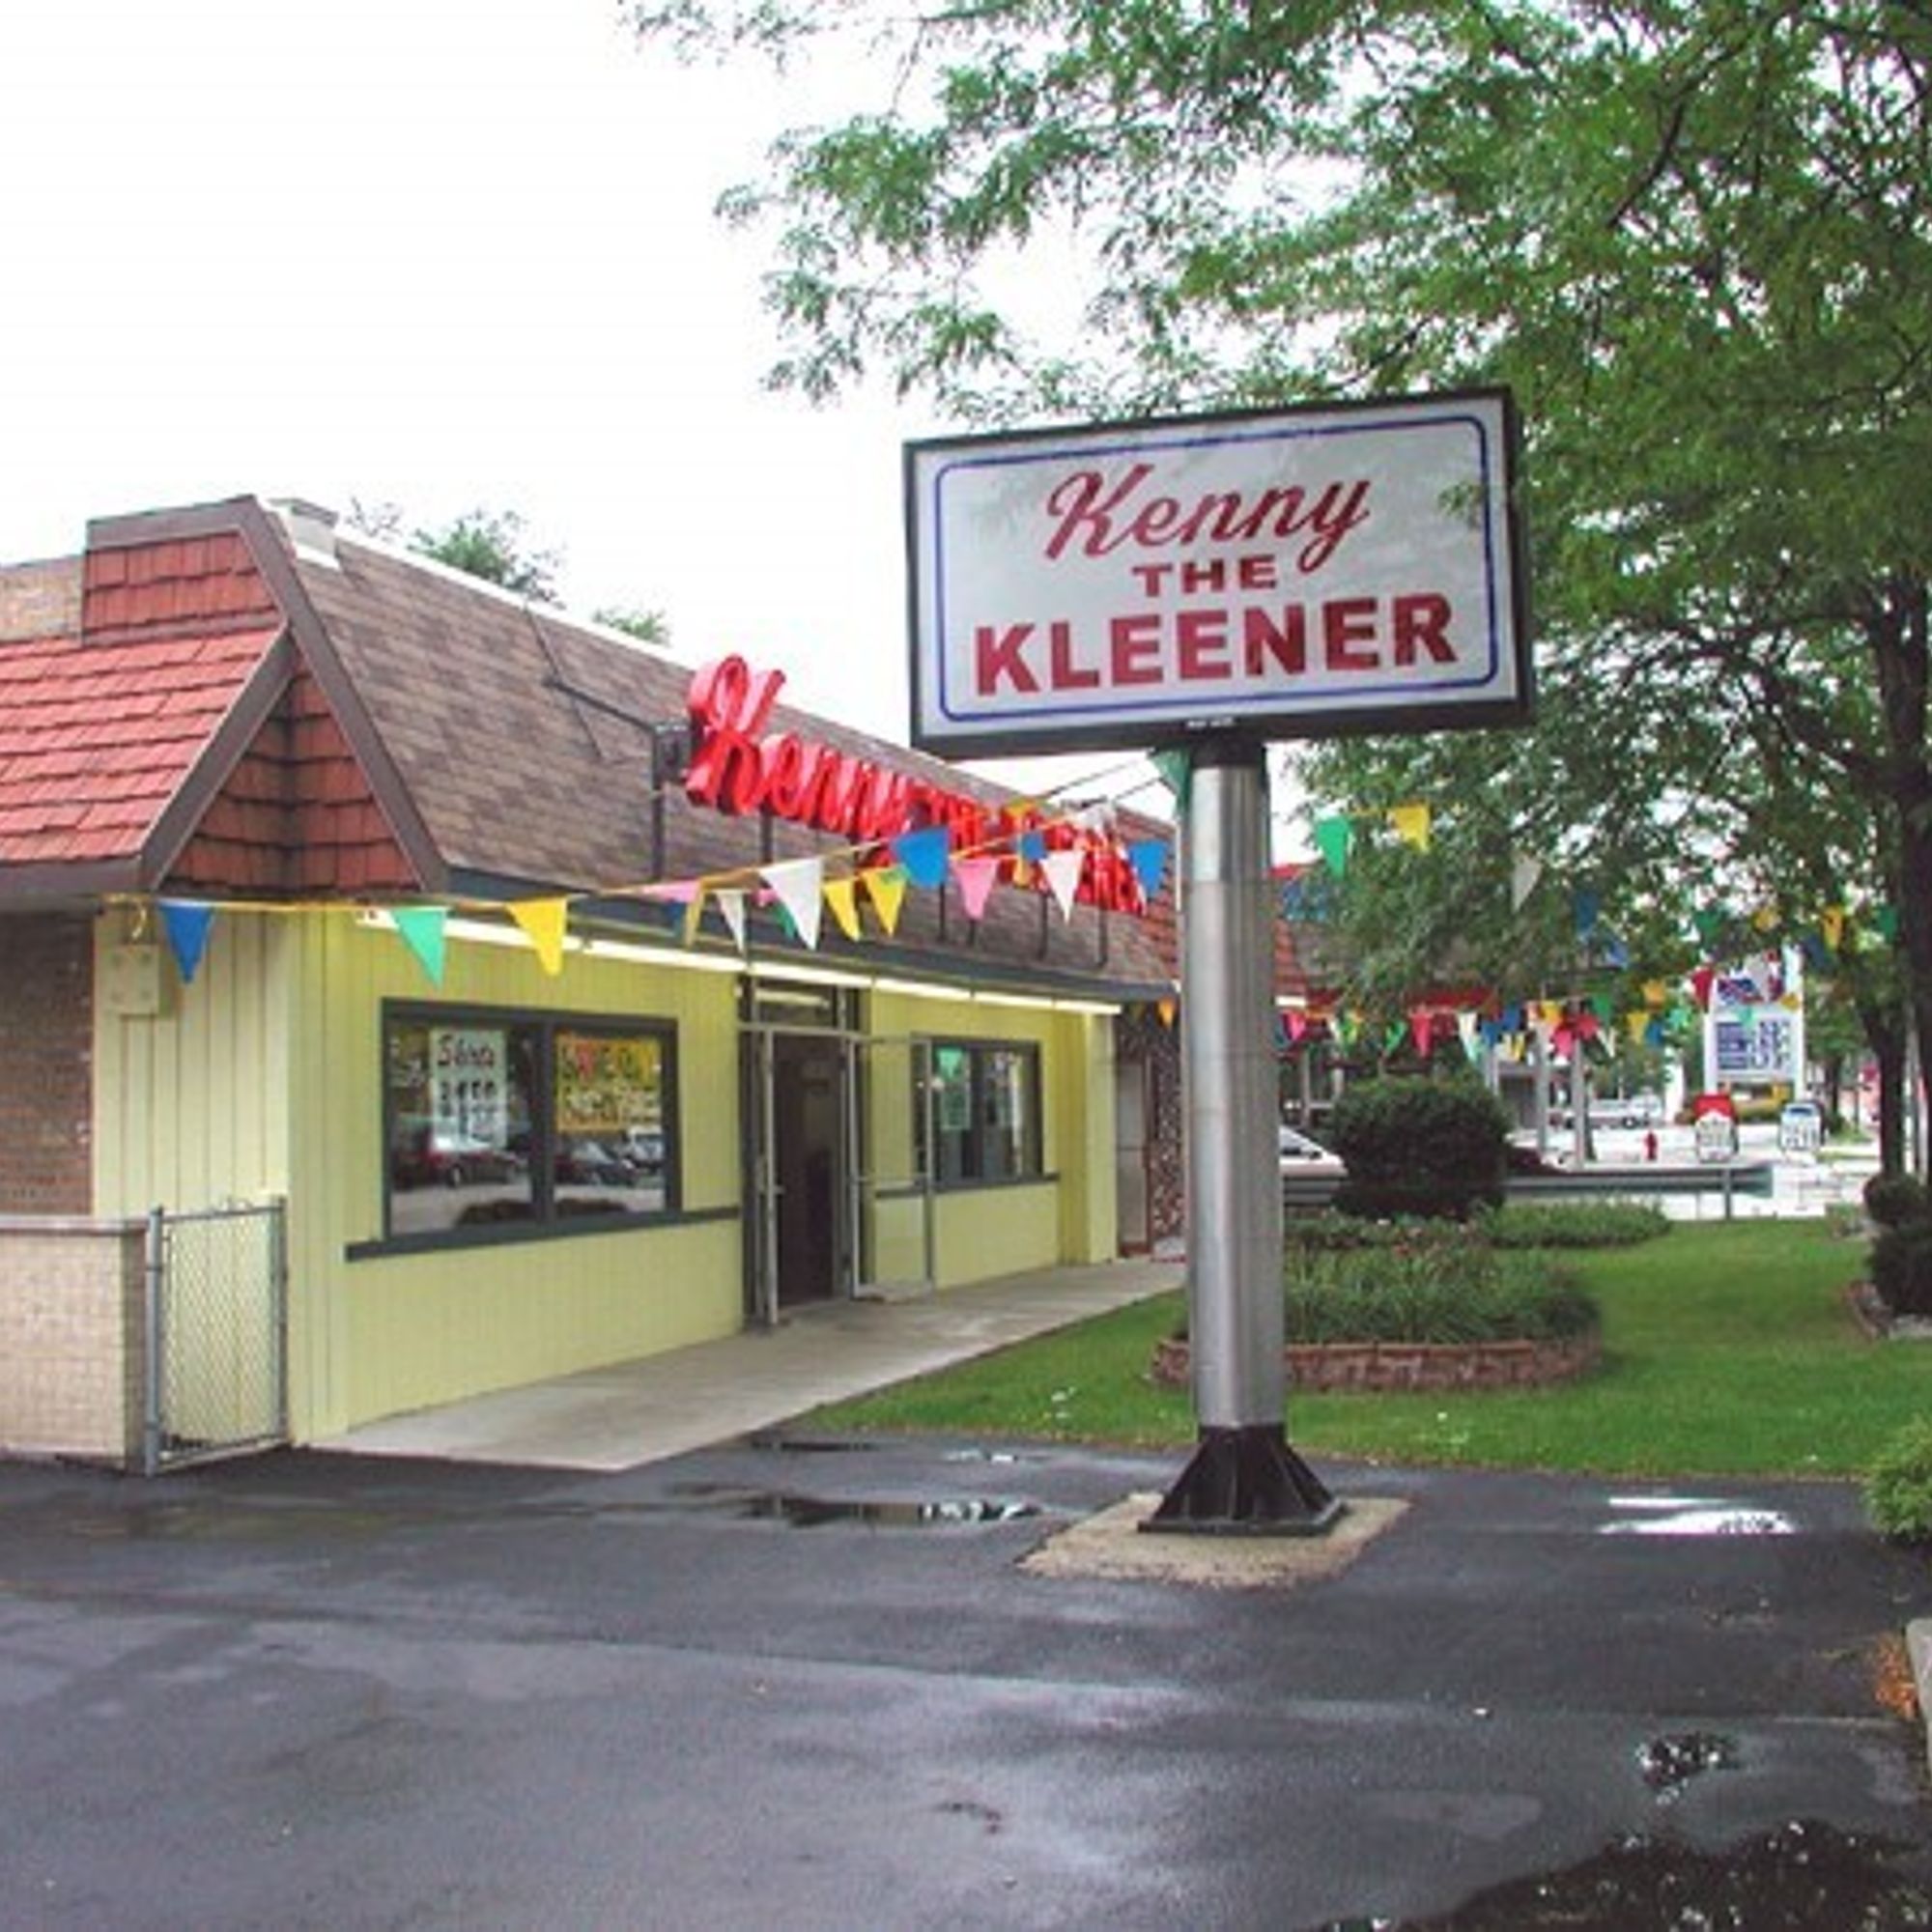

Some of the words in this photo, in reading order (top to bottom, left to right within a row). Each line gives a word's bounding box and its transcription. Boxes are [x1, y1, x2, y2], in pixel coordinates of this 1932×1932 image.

[1044, 464, 1370, 573] Kenny
[1133, 554, 1276, 597] THE
[976, 594, 1458, 696] KLEENER
